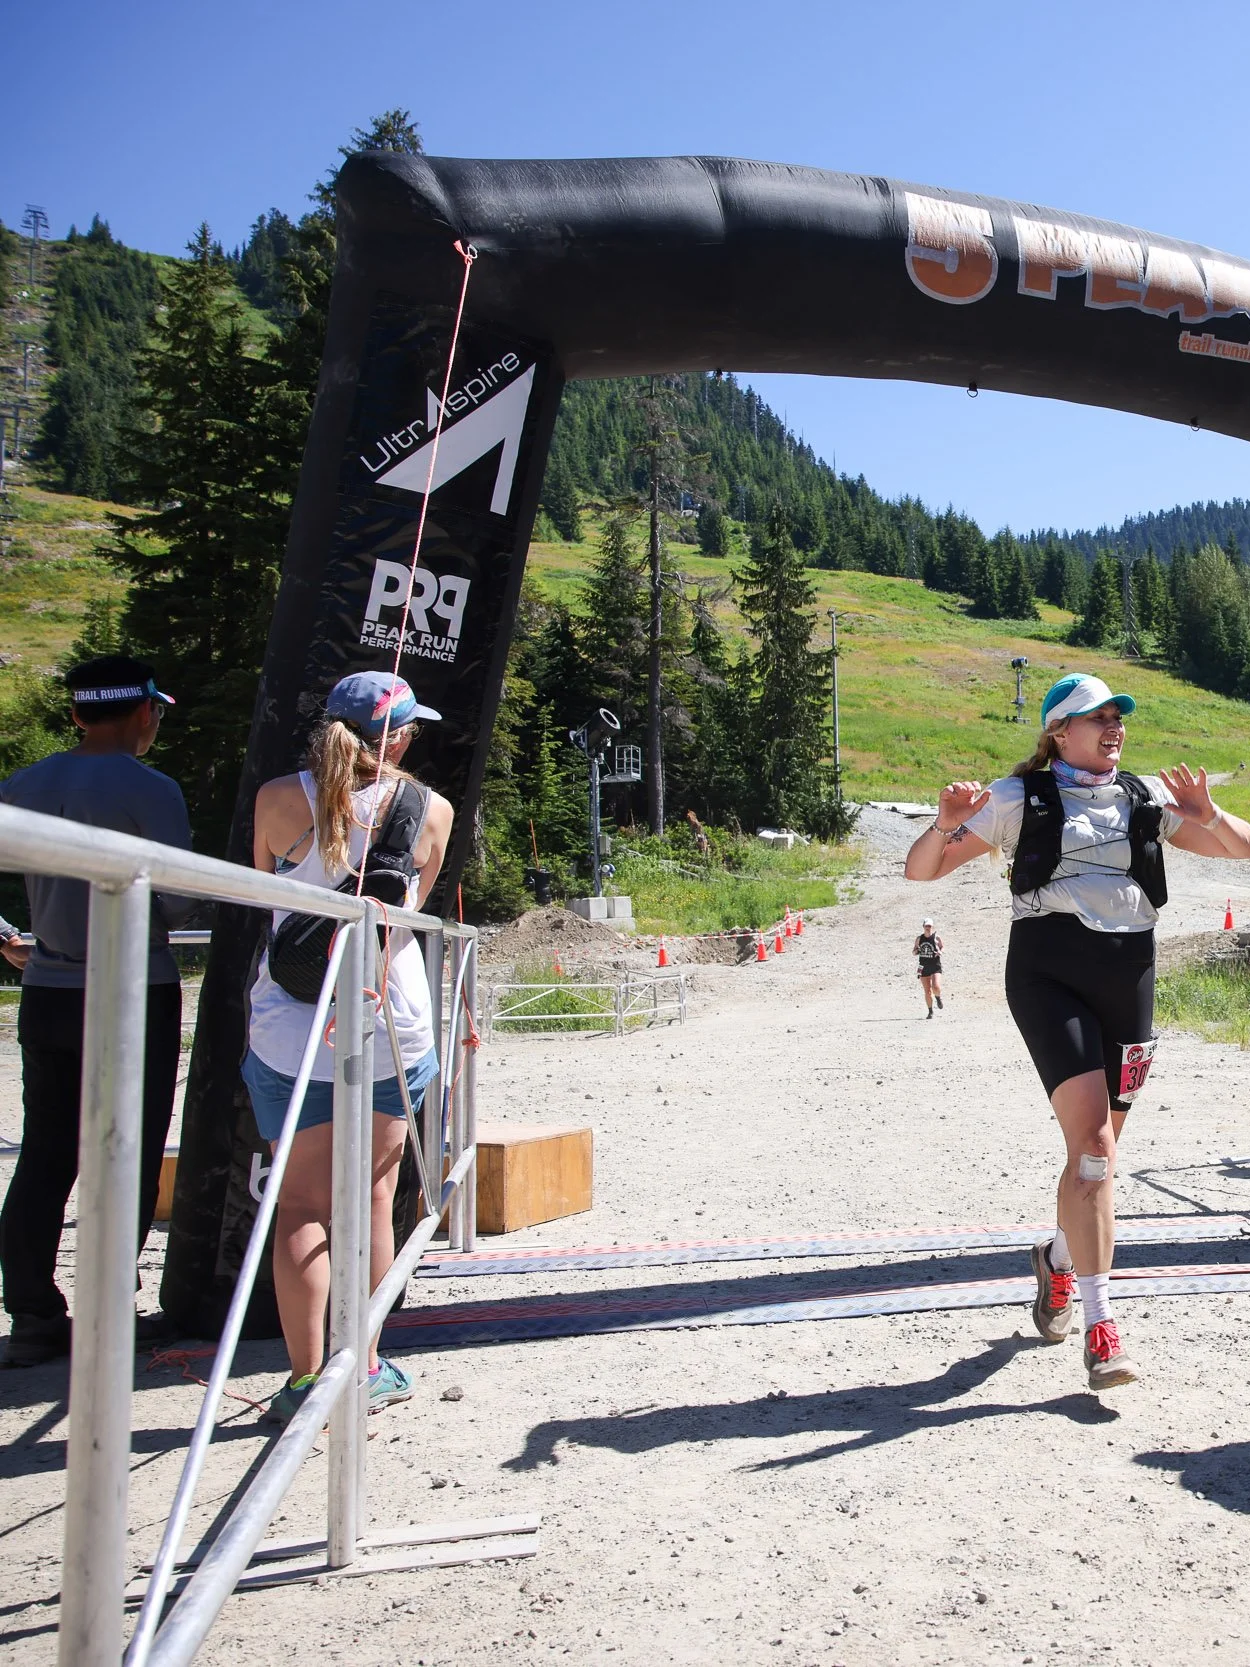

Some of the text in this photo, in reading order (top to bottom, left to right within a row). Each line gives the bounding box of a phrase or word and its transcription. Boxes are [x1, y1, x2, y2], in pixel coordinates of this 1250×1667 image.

[1180, 332, 1213, 354] trail
[360, 352, 520, 473] UltrAspire
[360, 635, 456, 663] PERFORMANCE
[361, 620, 458, 653] PEAK RUN
[101, 686, 143, 700] RUNNING
